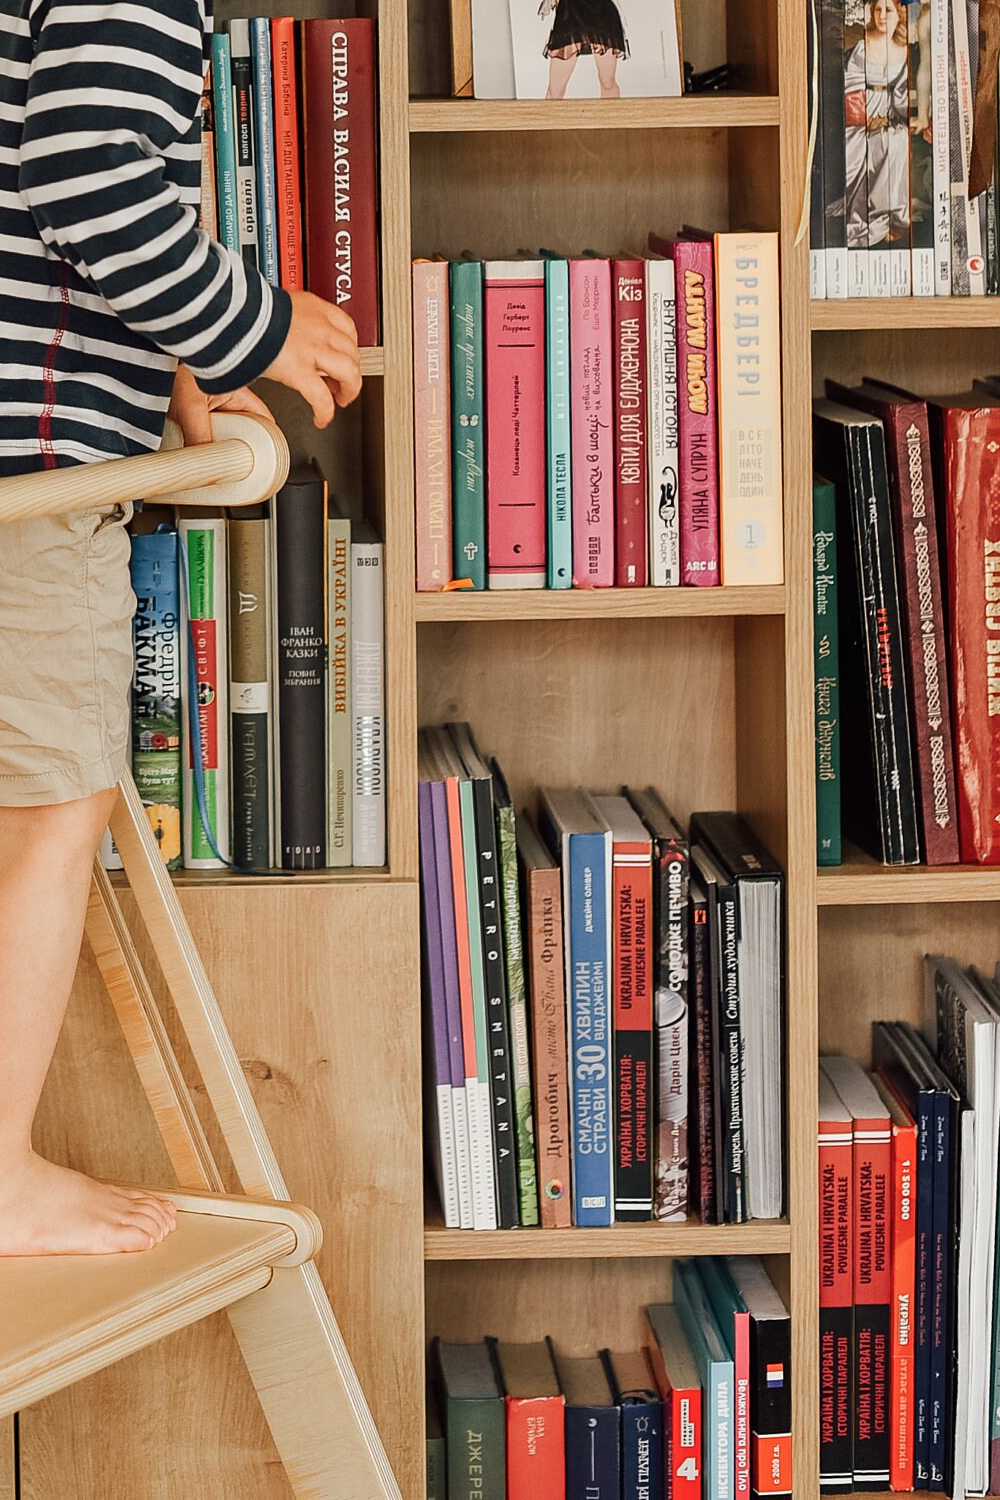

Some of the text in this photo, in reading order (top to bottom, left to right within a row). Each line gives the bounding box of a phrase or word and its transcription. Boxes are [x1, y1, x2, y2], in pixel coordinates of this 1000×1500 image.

[281, 41, 291, 116] Катерина Бабкіна
[283, 130, 292, 147] МІЙ
[283, 150, 293, 166] ДІД
[331, 31, 352, 305] СПРАВА ВАСИЛЯ СТУСА
[284, 168, 294, 216] ТАНЦЮВАВ
[286, 220, 296, 249] КРАЩЕ
[289, 265, 298, 285] ВСІХ
[621, 318, 643, 409] ЕЛДЖЕРНОНА
[662, 299, 678, 450] ВНУТРІШНЯ ІСТОРІЯ
[684, 269, 708, 415] МОЧИ МАНТУ
[621, 413, 644, 443] ДЛЯ
[555, 452, 567, 521] НІКОЛА ТЕСЛА
[689, 433, 709, 532] УЛЯНА СУПРУН
[746, 524, 756, 544] 1
[135, 596, 158, 719] БАКМАН
[154, 612, 178, 701] Фредрік
[280, 637, 323, 647] ФРАНКО
[286, 649, 319, 658] КАЗКИ
[290, 626, 314, 636] ІВАН
[331, 537, 347, 714] ВИБІЙКА В УКРАЇНІ
[355, 715, 382, 797] КЛАРКСОН
[582, 866, 594, 933] ДЖЕЙМІ ОЛІВЕР
[667, 861, 683, 992] СОЛОДКЕ ПЕЧИВО
[619, 884, 633, 1010] UKRAJINA HRVATSKA:
[635, 898, 647, 997] POVIJESNE PARALELE
[723, 901, 740, 1019] Студия художника
[481, 851, 511, 1159] PETRO SMETANA
[539, 895, 564, 1158] Дрогобич Франка
[592, 960, 607, 1040] ВІД ДЖЕЙМІ
[575, 960, 606, 1156] СМАЧНІ 30 ХВИЛИН
[668, 1060, 683, 1095] Дарія
[728, 1031, 742, 1064] советы
[594, 1087, 608, 1156] СТРАВИ
[619, 1054, 633, 1169] УКРАЇНА ХОРВАТІЯ:
[635, 1060, 647, 1161] ІСТОРИЧНІ ПАРАЛЕЛІ
[822, 1164, 835, 1287] UKRAJINA HRVATSKA:
[837, 1176, 849, 1274] POVIJESNE PARALELE
[858, 1161, 872, 1284] UKRAJINA HRVATSKA:
[874, 1173, 886, 1272] POVIJESNE PARALELE
[822, 1331, 835, 1443] УКРАЇНА ХОРВАТІЯ:
[837, 1337, 849, 1437] ІСТОРИЧНІ ПАРАЛЕЛІ
[858, 1328, 872, 1440] УКРАЇНА ХОРВАТІЯ:
[874, 1334, 886, 1434] ІСТОРИЧНІ ПАРАЛЕЛІ
[899, 1358, 909, 1394] атлас
[676, 1457, 699, 1481] 4
[717, 1421, 729, 1499] ІНСПЕКТОРА
[736, 1379, 749, 1491] Велика книга про Тіло
[772, 1458, 781, 1477] 2009
[898, 1396, 909, 1470] автошляхів
